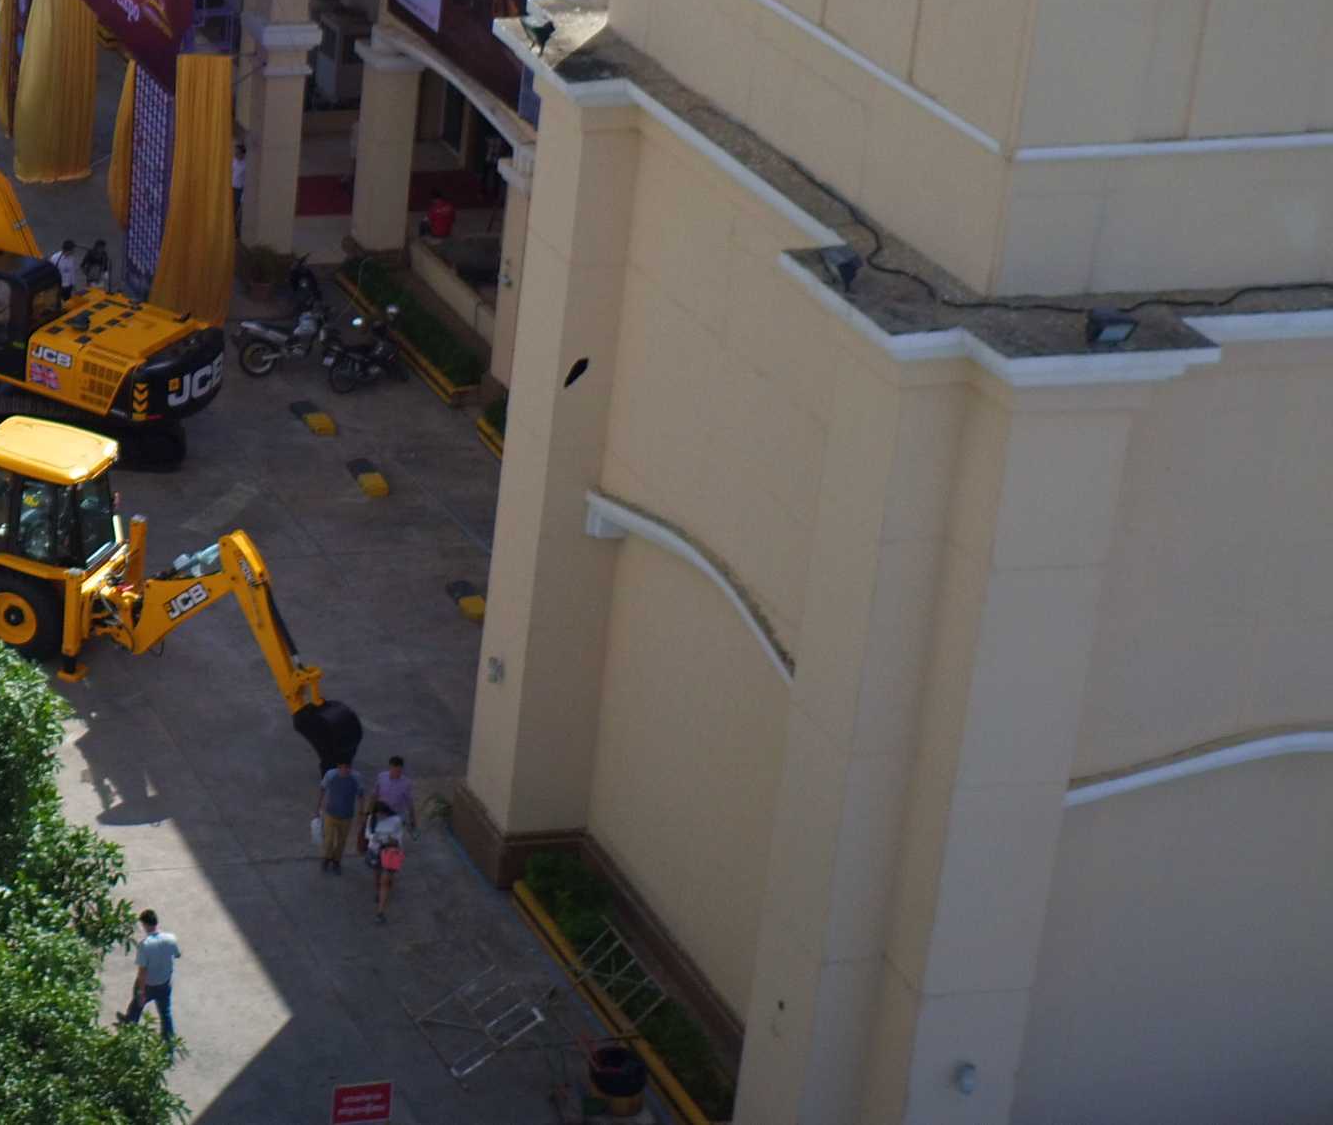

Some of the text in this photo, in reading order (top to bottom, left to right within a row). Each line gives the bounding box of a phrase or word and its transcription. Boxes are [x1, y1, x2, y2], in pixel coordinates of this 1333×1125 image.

[32, 346, 72, 368] JCB
[168, 351, 224, 407] JCB
[167, 583, 209, 619] JCB
